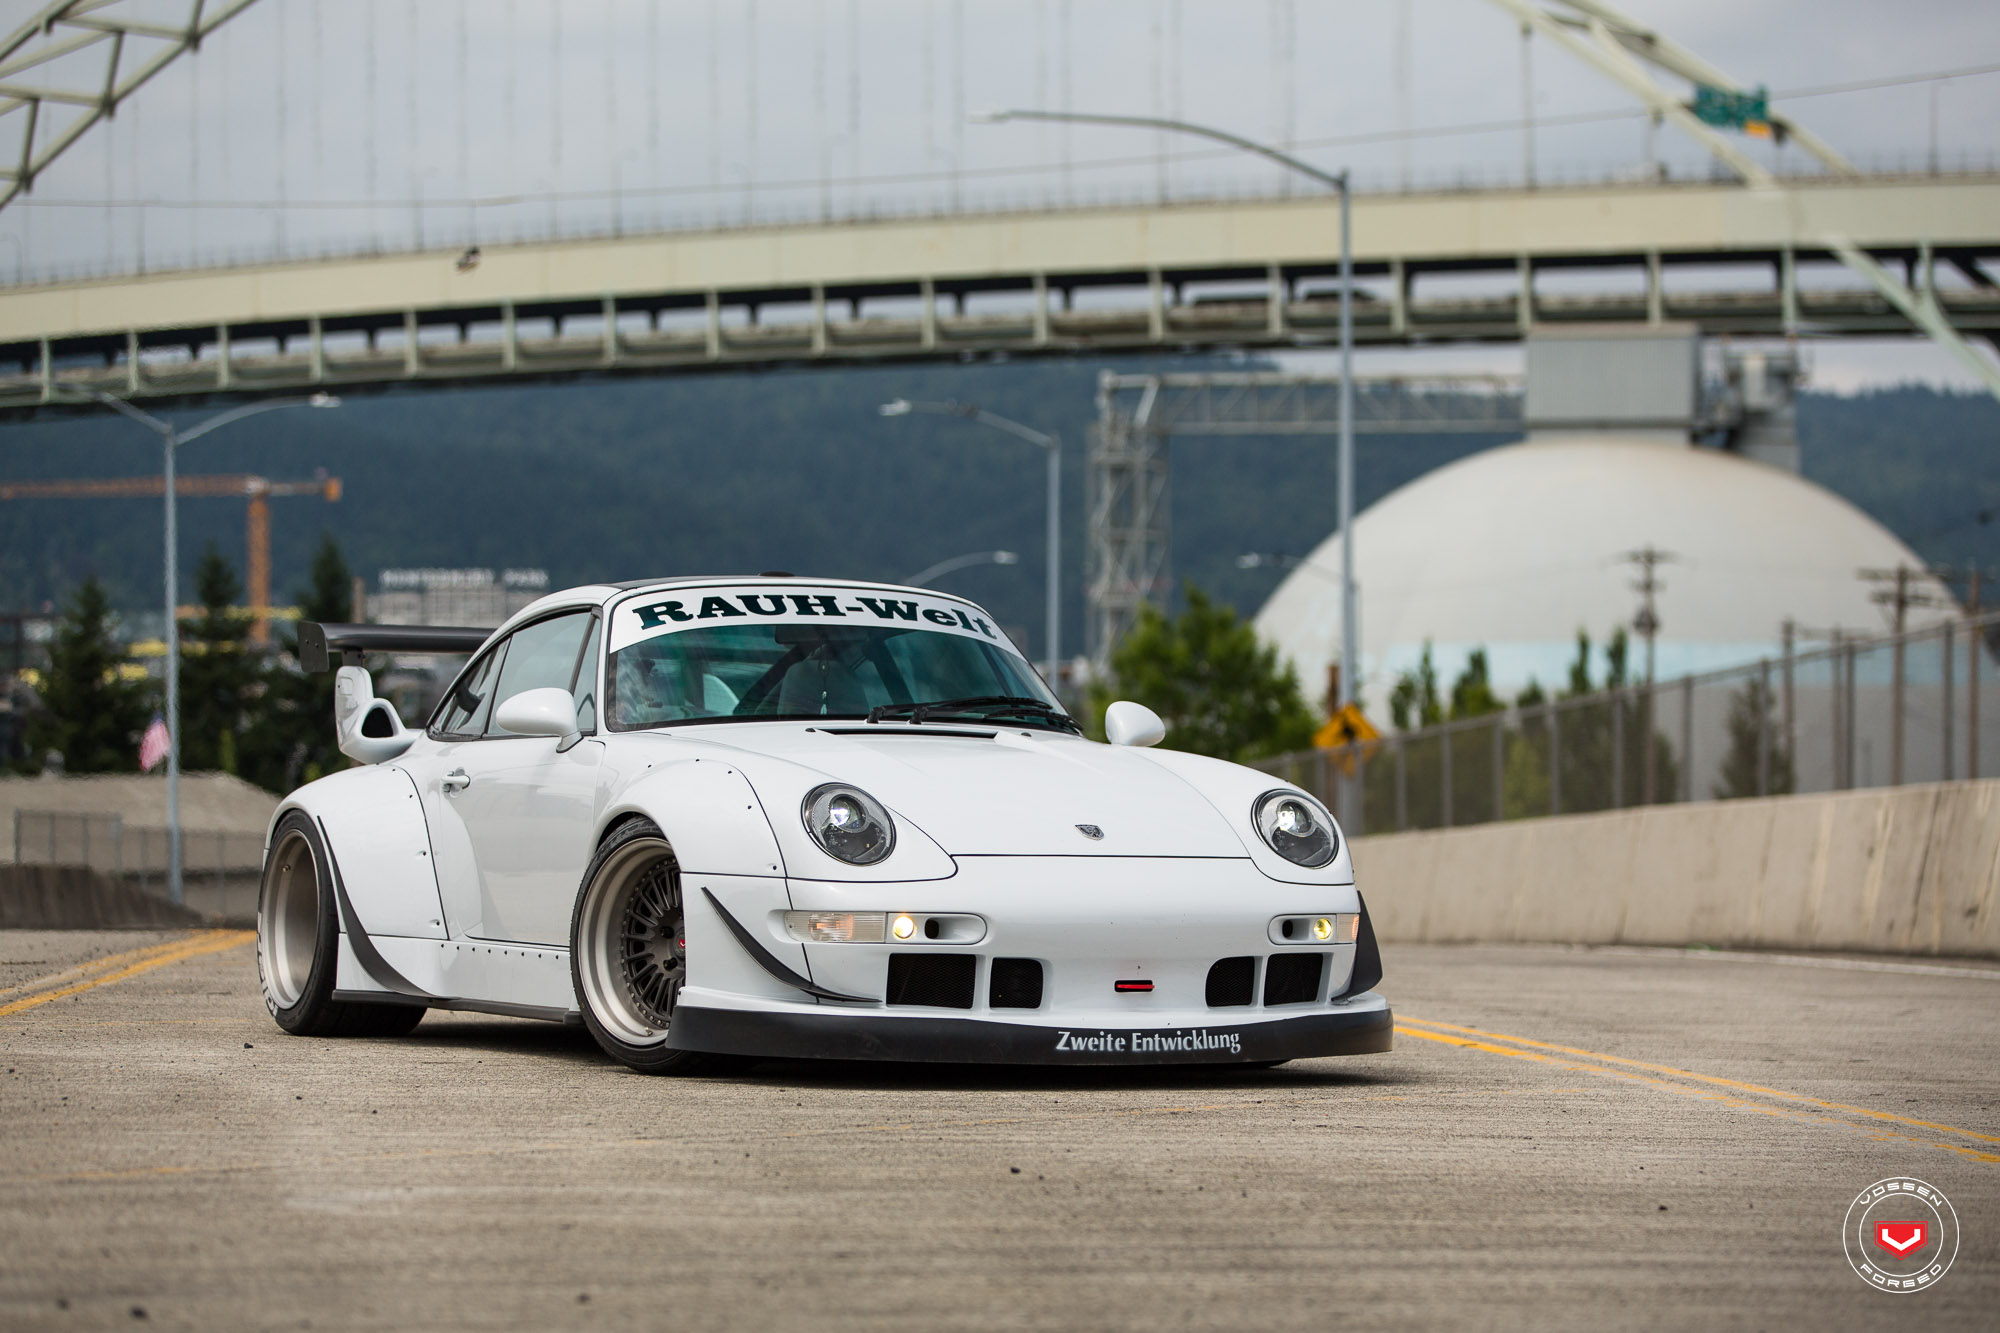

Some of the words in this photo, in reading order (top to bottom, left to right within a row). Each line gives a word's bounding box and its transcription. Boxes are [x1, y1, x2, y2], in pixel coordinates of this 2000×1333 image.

[632, 594, 997, 640] RAUH-Welt
[1055, 1030, 1126, 1052] Zweite
[1131, 1029, 1241, 1054] Entwicklung
